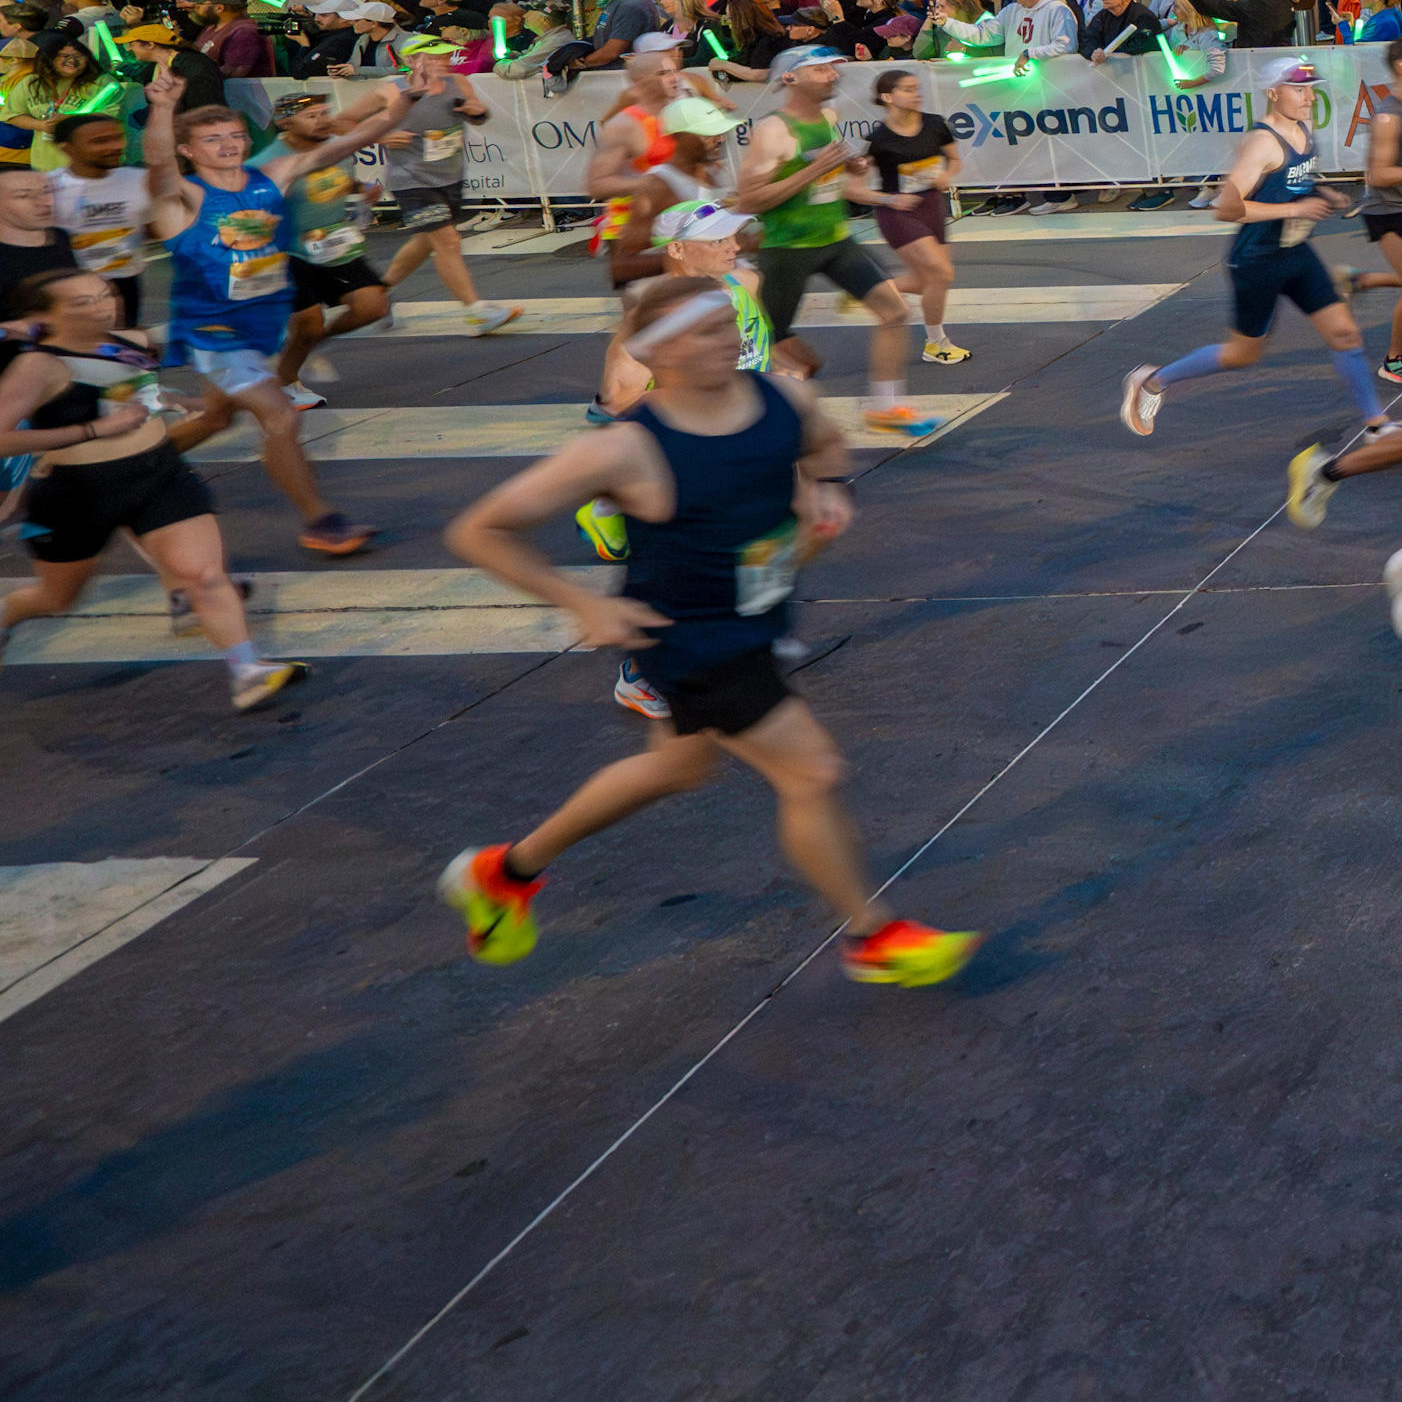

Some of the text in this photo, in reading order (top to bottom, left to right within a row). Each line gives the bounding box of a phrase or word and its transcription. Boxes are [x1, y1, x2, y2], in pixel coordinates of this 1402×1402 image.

[948, 97, 1129, 148] expand
[1150, 88, 1332, 135] HOMELD
[463, 174, 505, 191] spital
